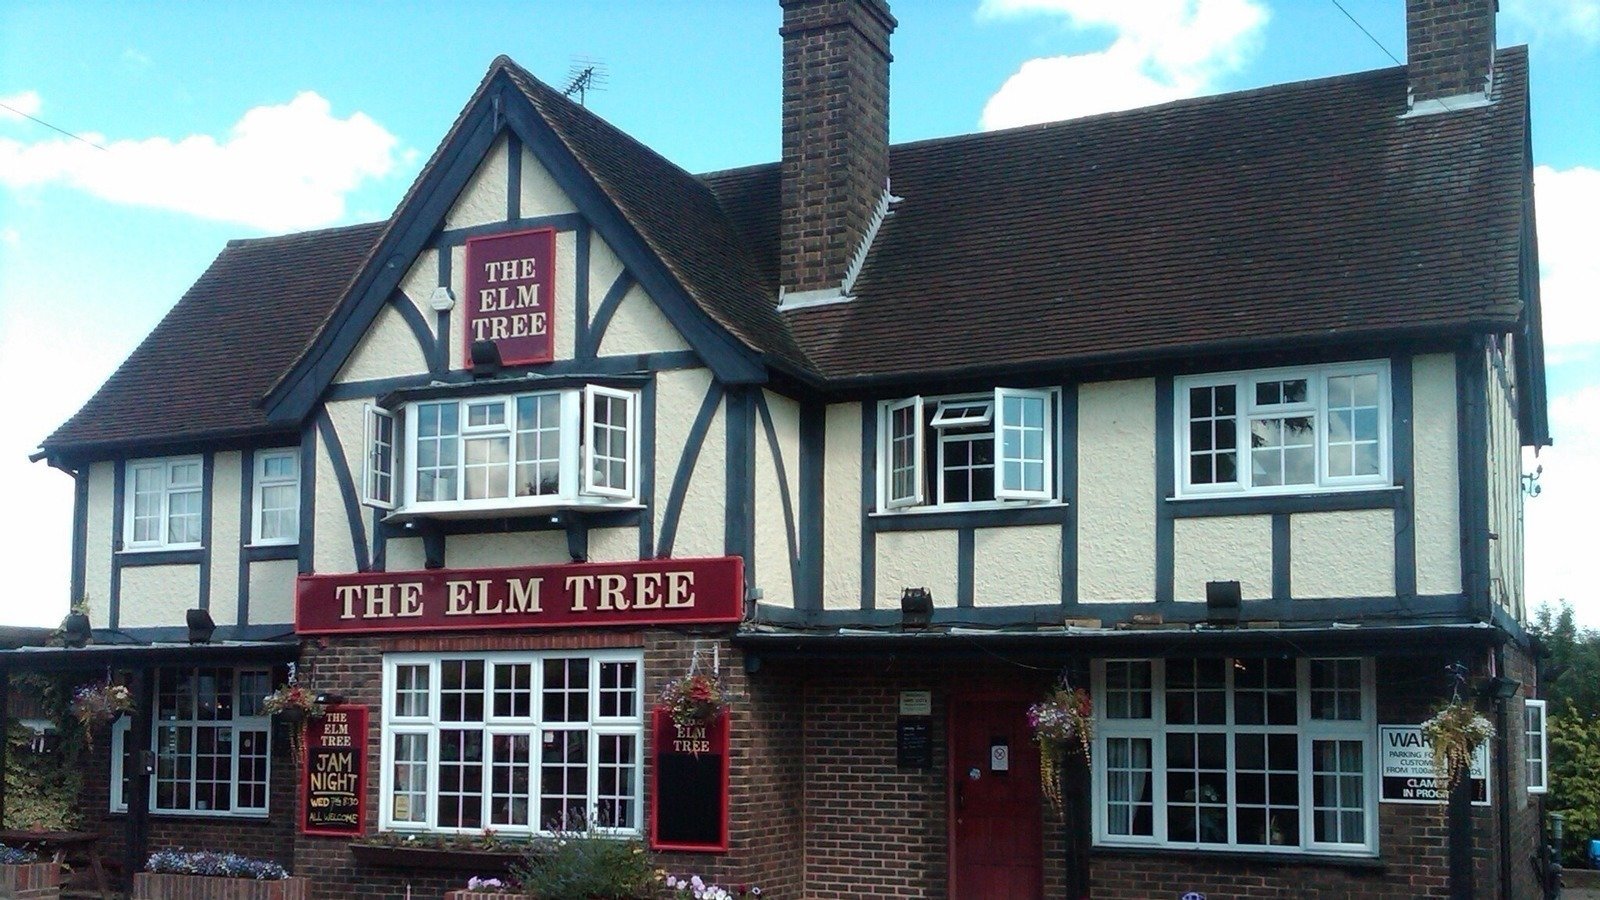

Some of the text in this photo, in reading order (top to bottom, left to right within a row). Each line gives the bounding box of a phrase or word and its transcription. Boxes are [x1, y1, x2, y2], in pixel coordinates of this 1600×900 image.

[485, 258, 536, 282] THE
[479, 284, 540, 312] ELM
[472, 312, 547, 341] TREE
[336, 571, 696, 619] THE ELM TREE
[326, 713, 347, 722] THE
[324, 724, 348, 735] ELM
[677, 727, 706, 738] ELM
[321, 736, 351, 746] TREE
[673, 740, 710, 752] TREE
[1389, 750, 1422, 758] PARKING
[317, 752, 353, 772] JAM
[310, 772, 358, 792] NIGHT
[1402, 789, 1413, 797] IN
[310, 798, 330, 807] WED
[309, 811, 358, 823] ALL WELCOME
